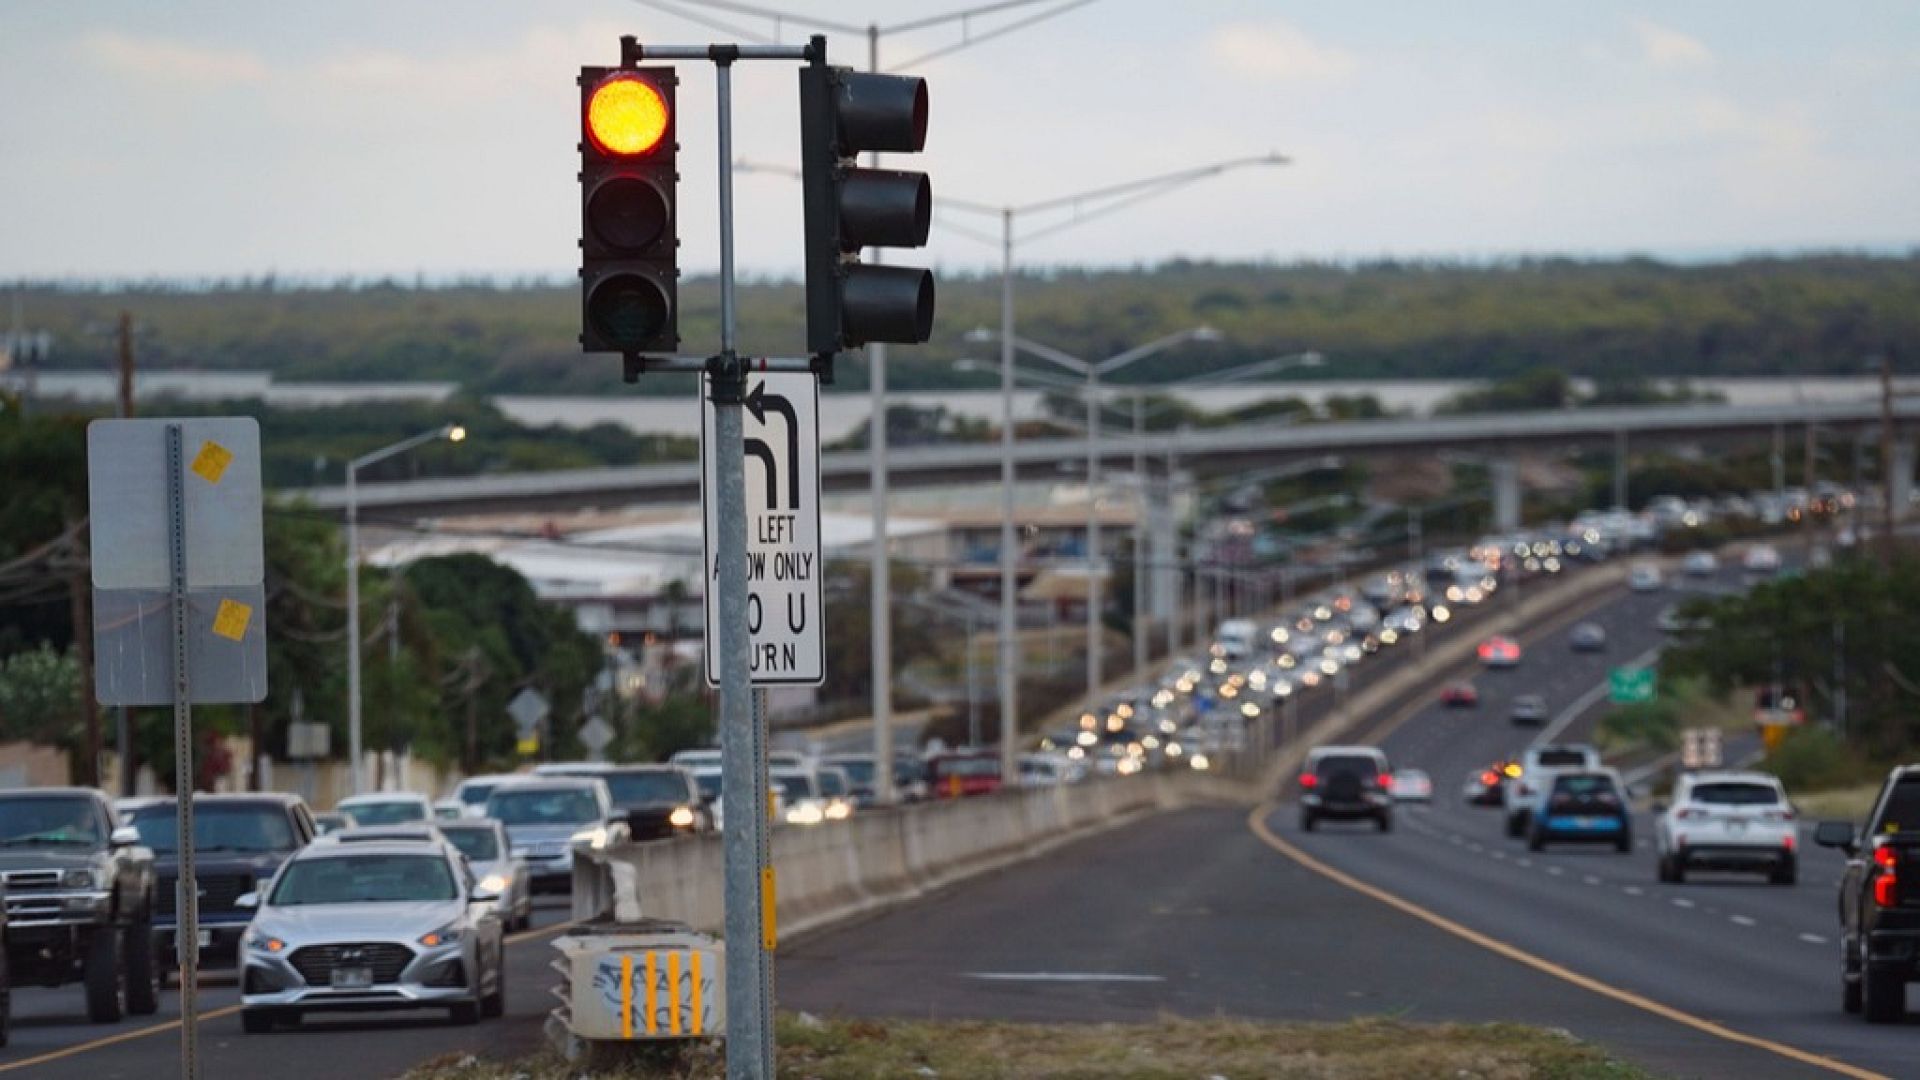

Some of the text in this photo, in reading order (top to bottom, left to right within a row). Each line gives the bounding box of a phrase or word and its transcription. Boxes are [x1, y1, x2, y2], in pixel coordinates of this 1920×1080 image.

[758, 515, 796, 544] LEFT
[774, 552, 813, 581] ONLY
[787, 592, 806, 635] U
[749, 643, 796, 672] URN
